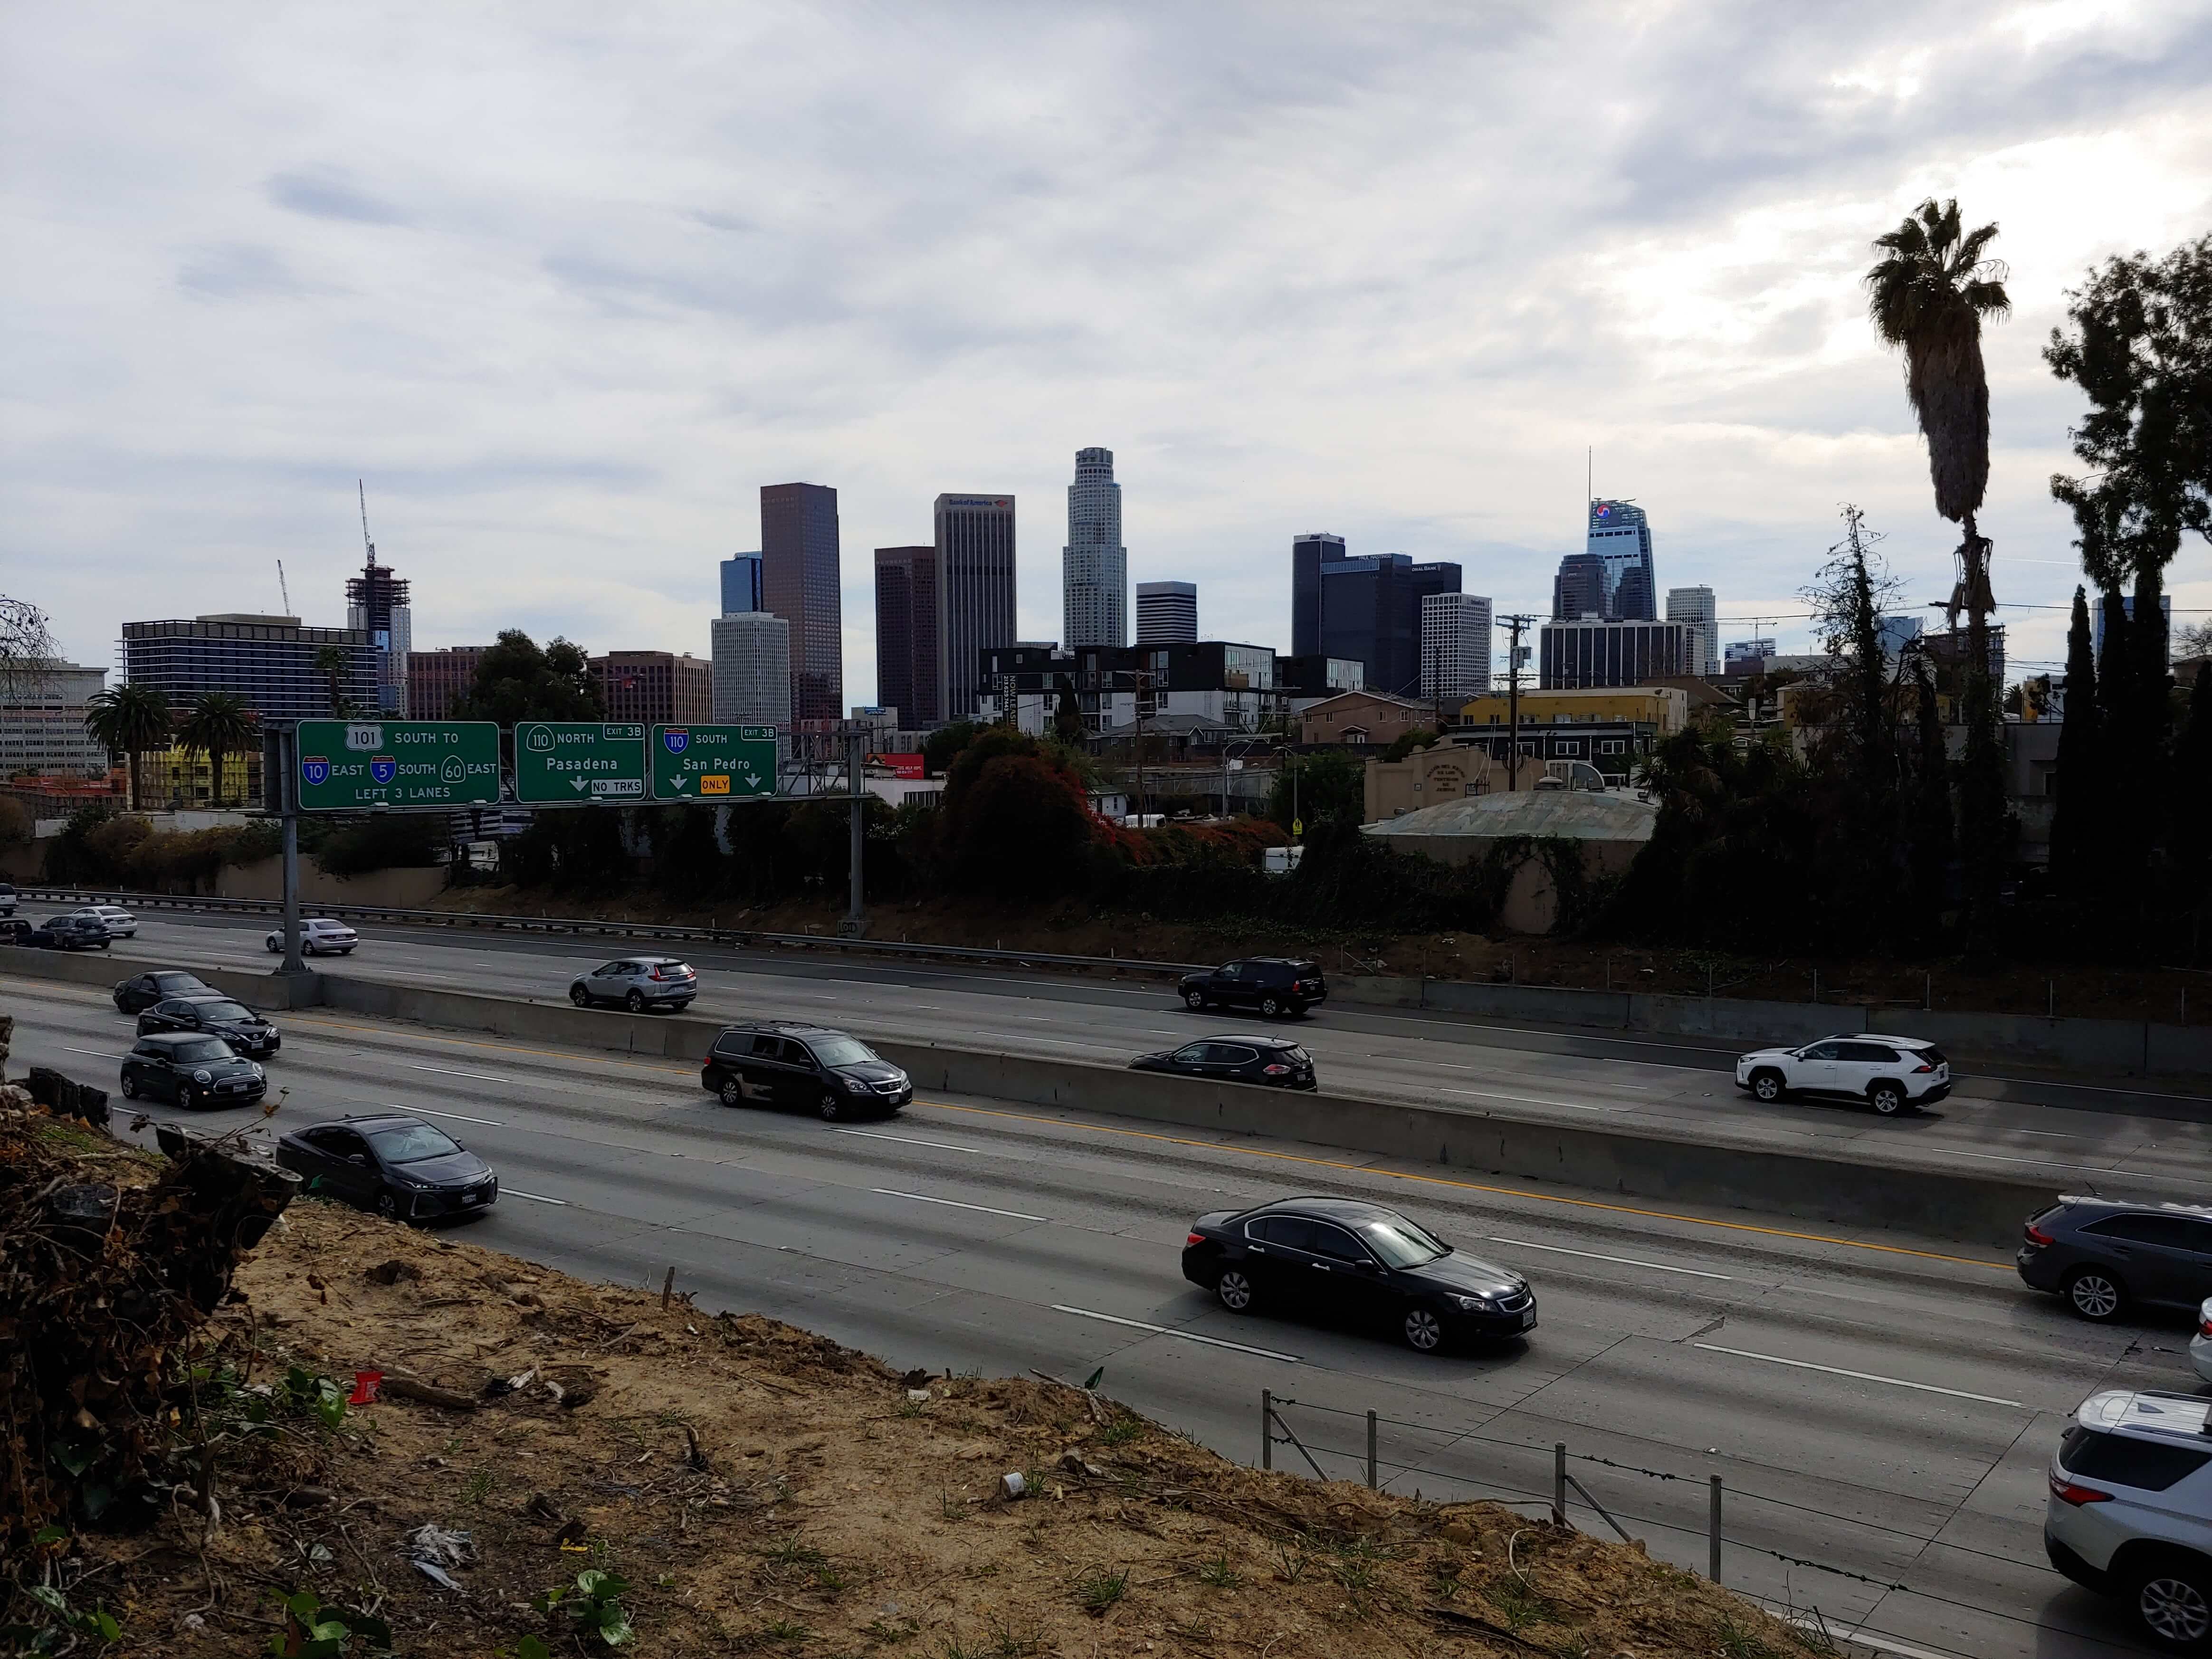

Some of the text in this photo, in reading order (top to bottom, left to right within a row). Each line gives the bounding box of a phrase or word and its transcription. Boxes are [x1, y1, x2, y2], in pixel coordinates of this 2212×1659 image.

[354, 731, 459, 744] 101 SOUTH TO
[627, 727, 641, 736] 3B
[762, 728, 774, 737] 3B
[534, 734, 594, 746] 110 NORTH
[670, 734, 727, 747] 110 SOUTH
[546, 758, 617, 770] Pasadena
[683, 758, 750, 770] San Pedro
[308, 763, 496, 779] 10 EAST 5 SOUTH 60 EAST
[593, 782, 641, 791] NO TRKS
[702, 780, 729, 789] ONLY
[355, 787, 450, 800] LEFT 3 LANES
